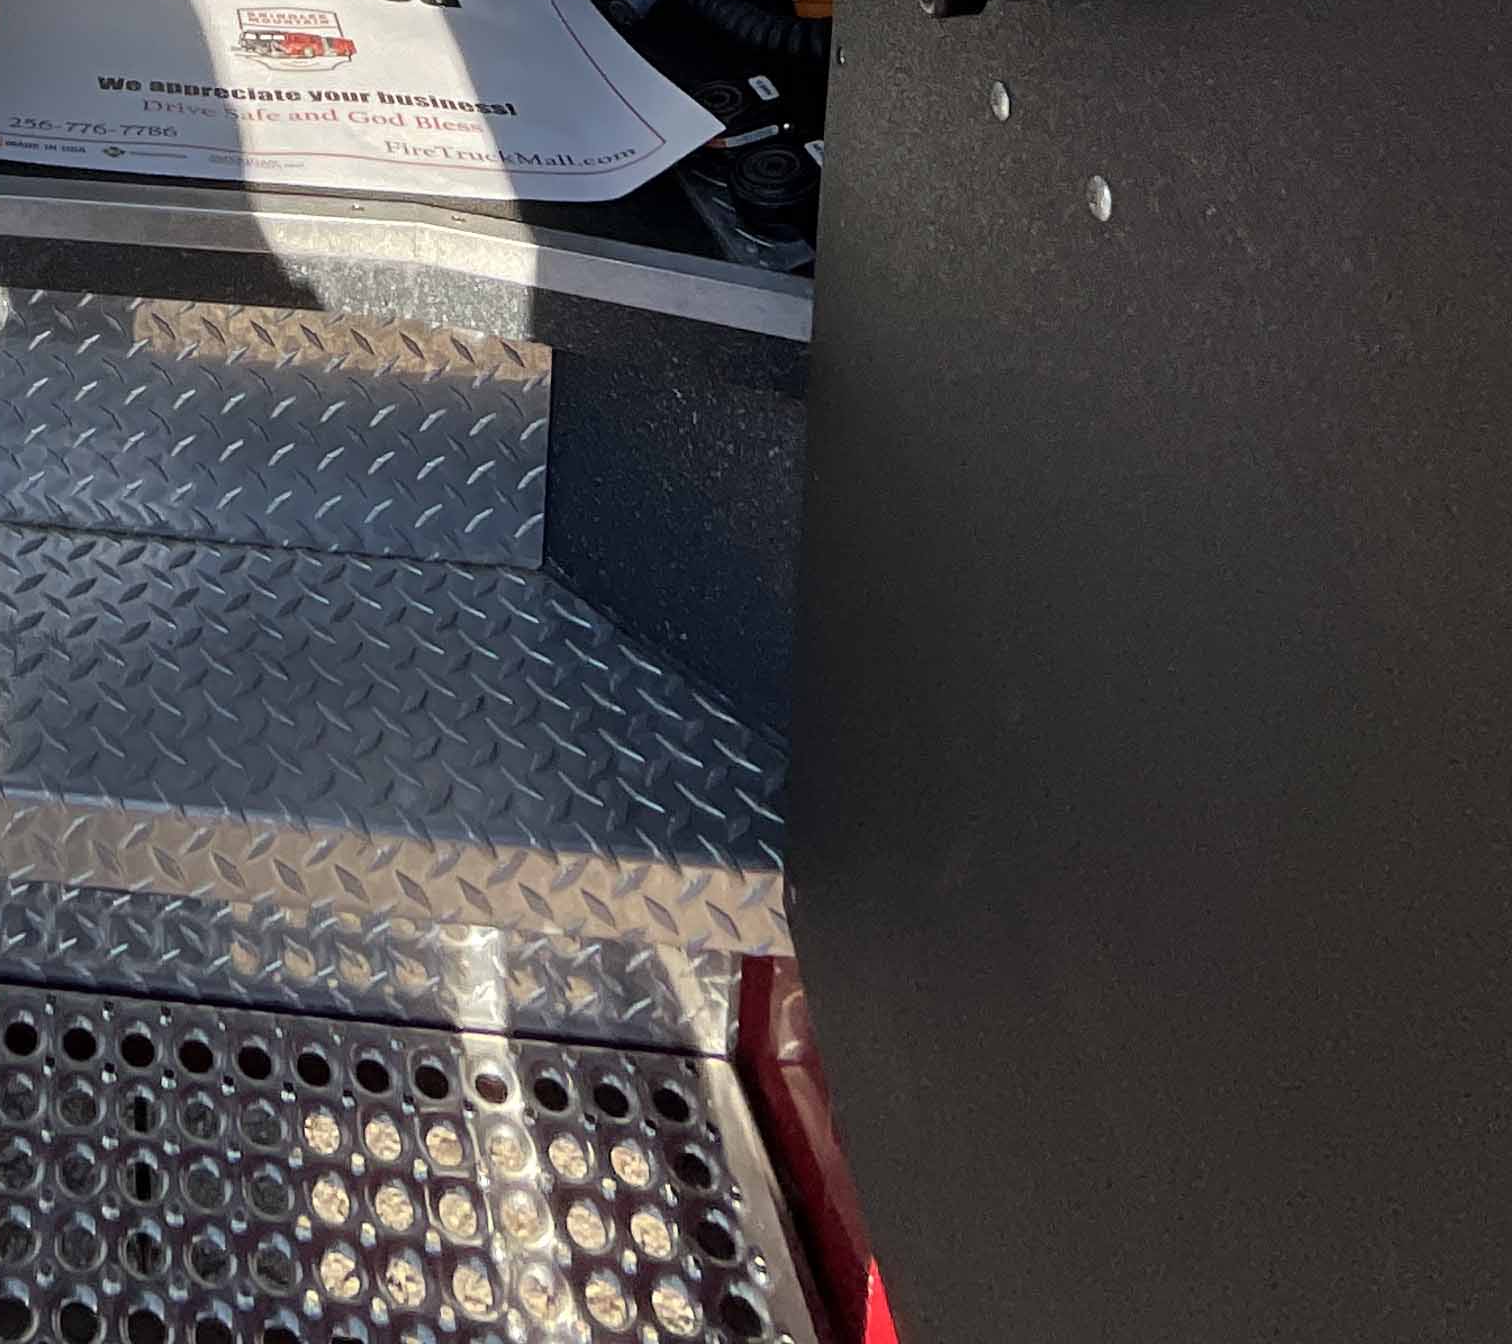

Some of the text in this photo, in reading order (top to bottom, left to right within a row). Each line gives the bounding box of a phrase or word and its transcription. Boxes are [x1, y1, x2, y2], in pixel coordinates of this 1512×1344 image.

[97, 76, 518, 117] We appreciate your business!
[143, 99, 485, 133] Drive Safe and God Bless
[384, 139, 637, 168] FireTruckMall.com
